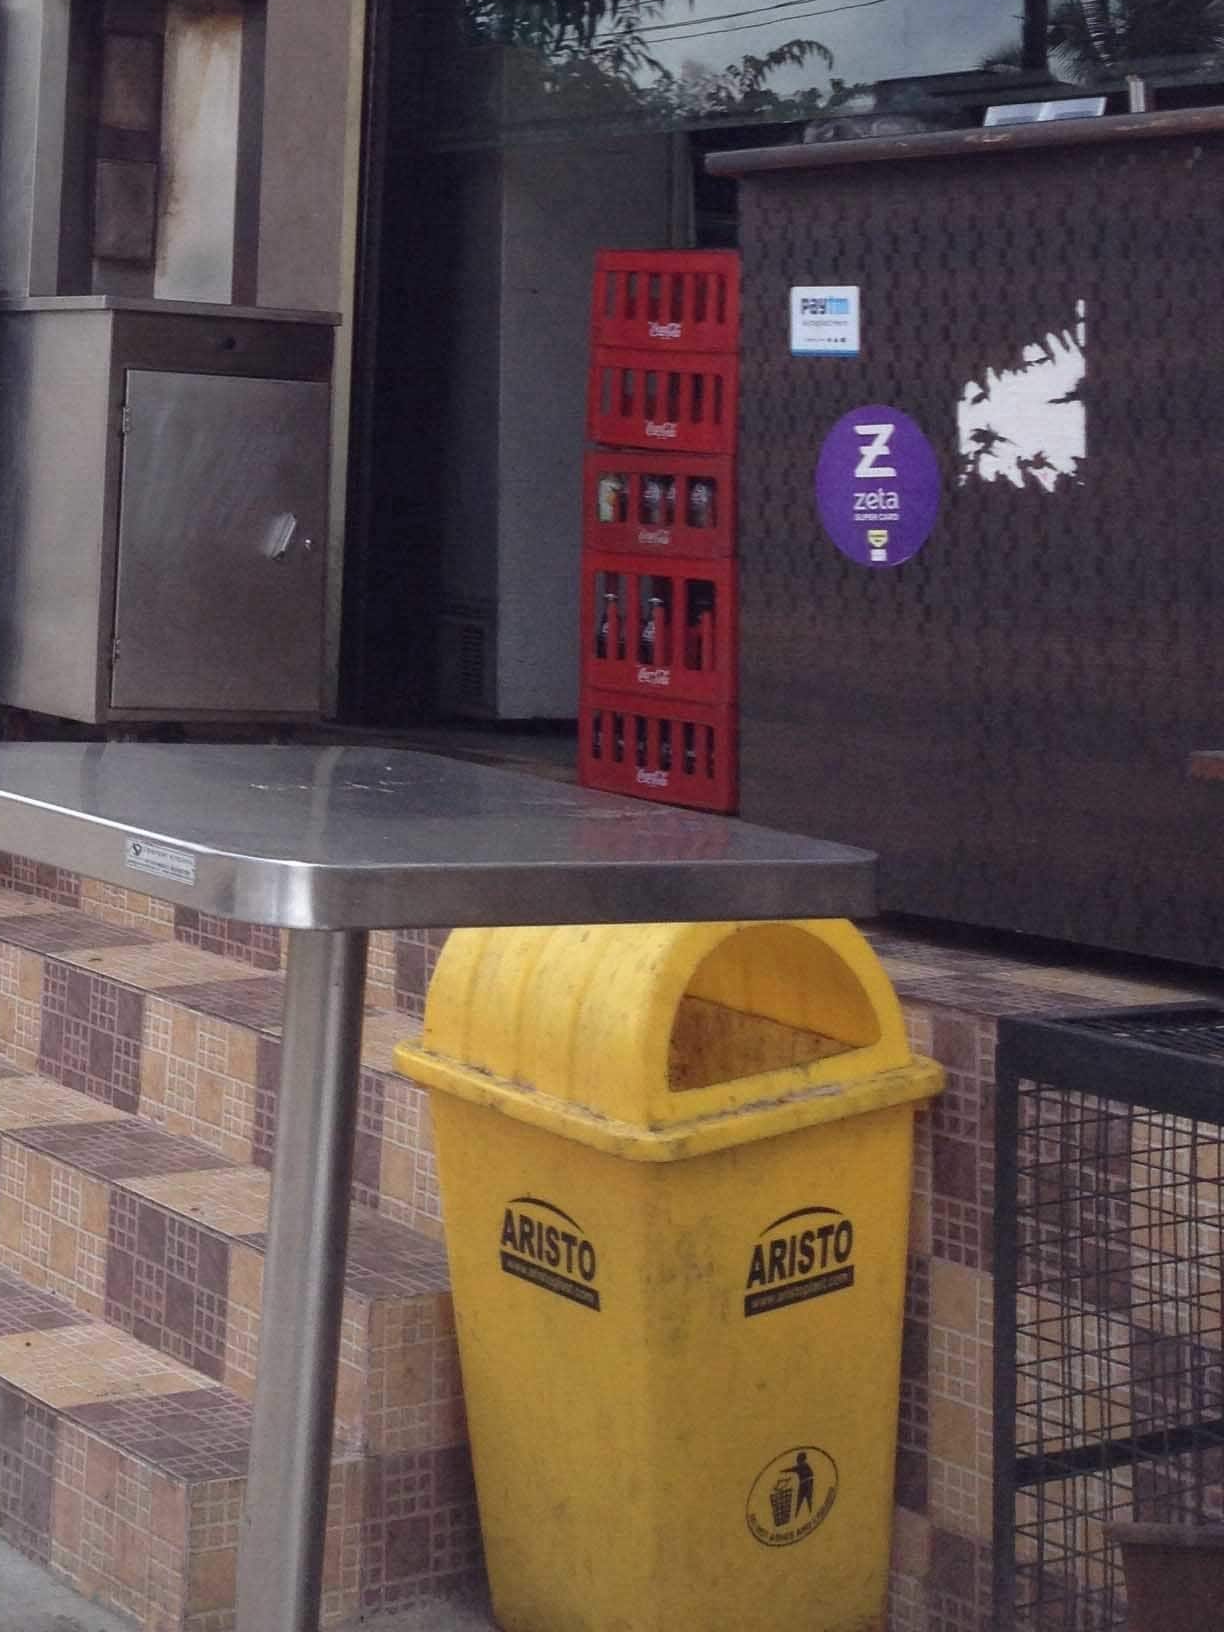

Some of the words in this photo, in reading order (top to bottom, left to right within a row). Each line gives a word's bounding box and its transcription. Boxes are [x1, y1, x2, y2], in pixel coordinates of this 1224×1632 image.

[853, 488, 900, 510] zeta
[500, 1208, 596, 1281] ARISTO
[746, 1219, 853, 1289] ARISTO
